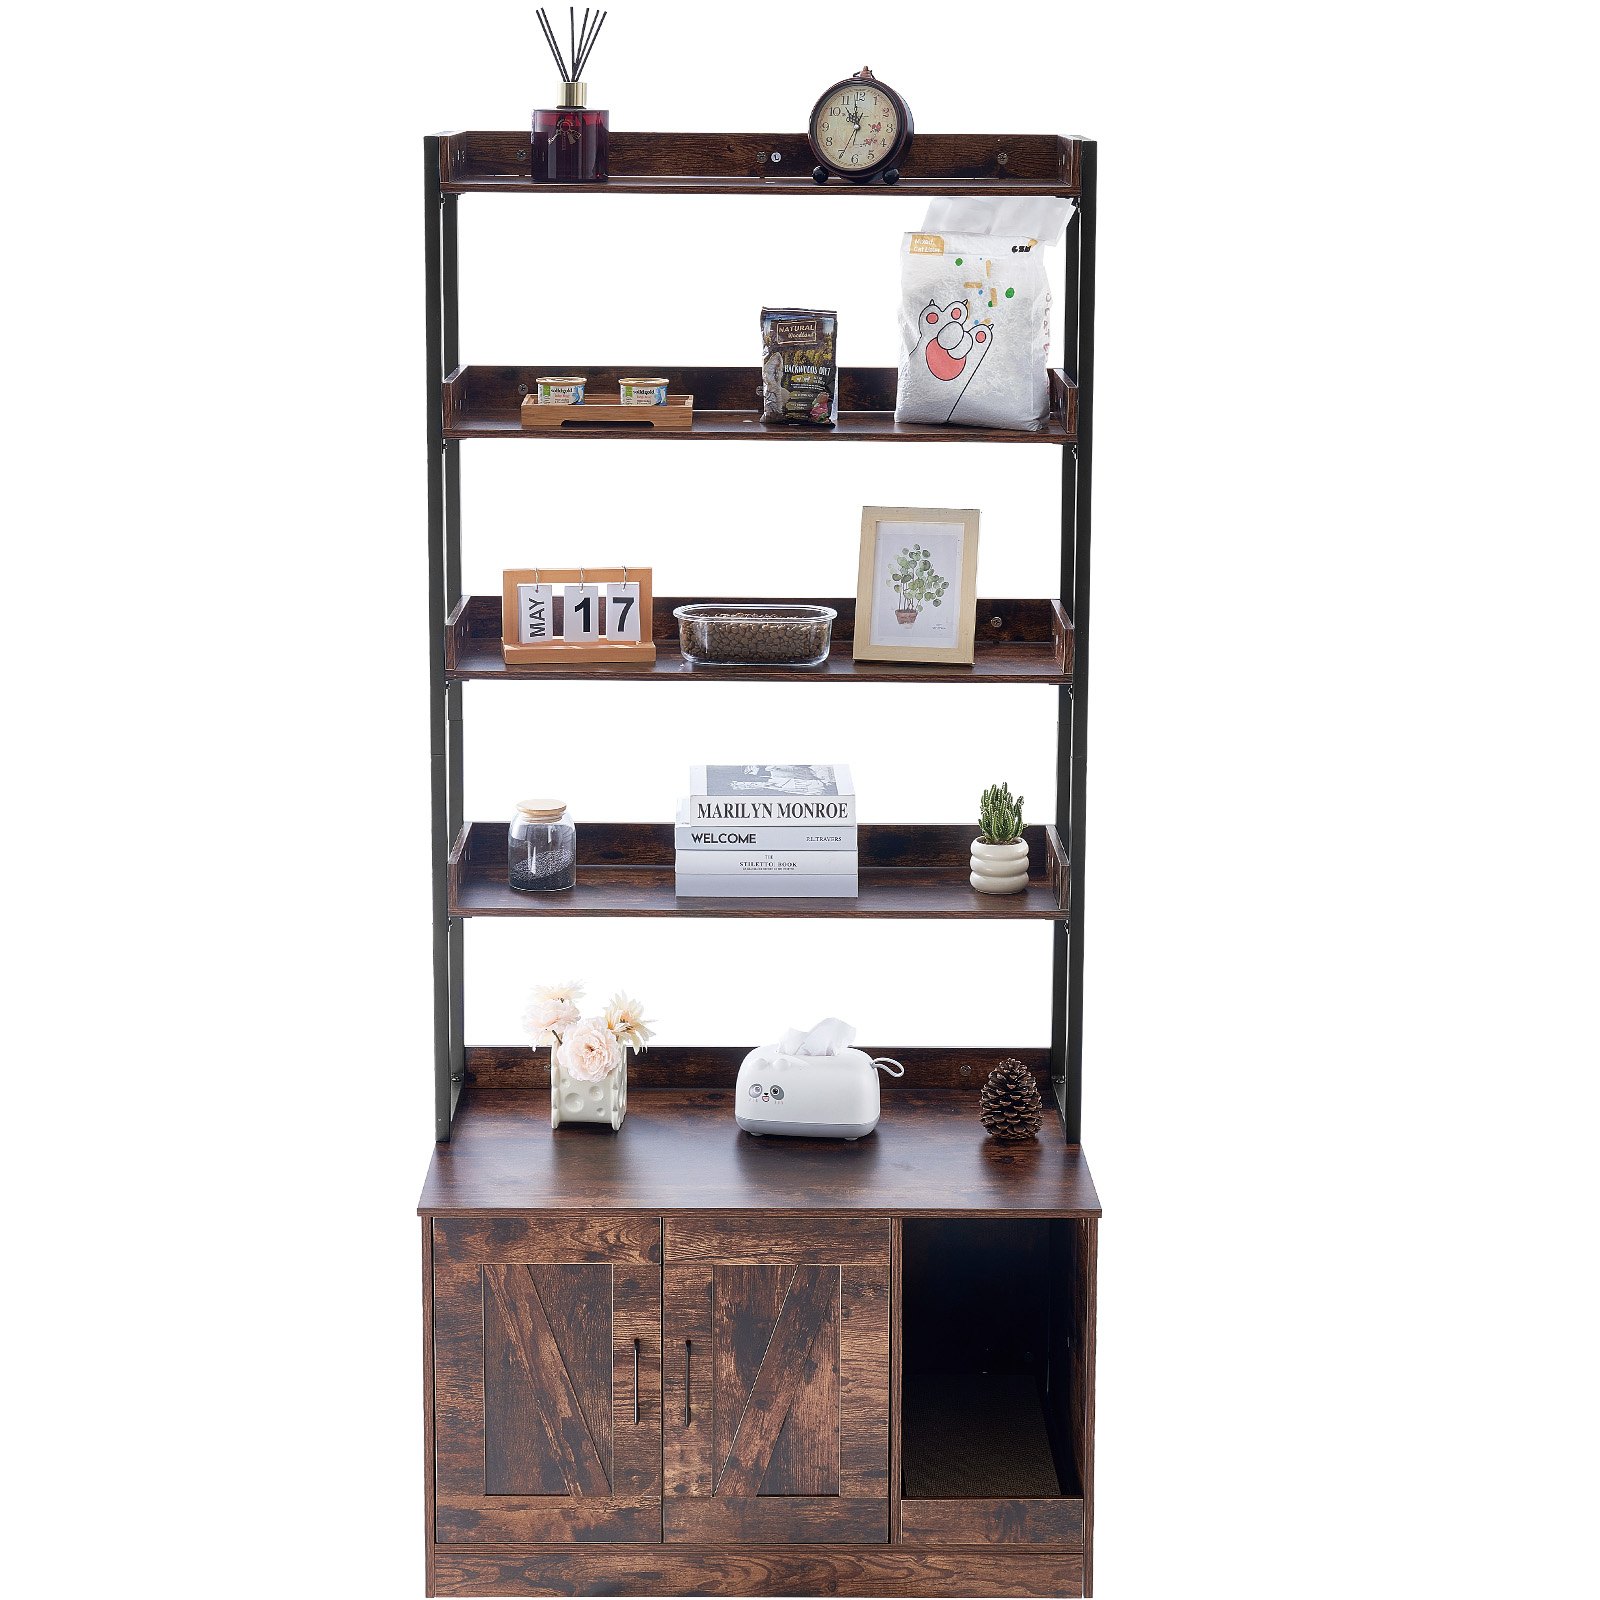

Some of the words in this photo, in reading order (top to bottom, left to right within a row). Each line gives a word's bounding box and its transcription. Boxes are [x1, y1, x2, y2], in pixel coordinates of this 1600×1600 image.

[841, 95, 850, 105] 11
[855, 91, 866, 102] 12
[873, 96, 878, 105] 1
[829, 106, 841, 117] 10
[882, 107, 890, 118] 2
[821, 121, 830, 132] 9
[886, 123, 894, 134] 3
[825, 136, 833, 147] 8
[880, 137, 887, 148] 4
[838, 149, 845, 160] 7
[851, 154, 859, 164] 6
[867, 149, 875, 161] 5
[778, 324, 815, 333] NATURAL
[528, 597, 546, 638] MAY
[574, 597, 591, 633] 1
[612, 596, 635, 633] 7
[697, 802, 773, 820] MARILYN
[776, 802, 848, 820] MONROE
[691, 833, 757, 844] WELCOME
